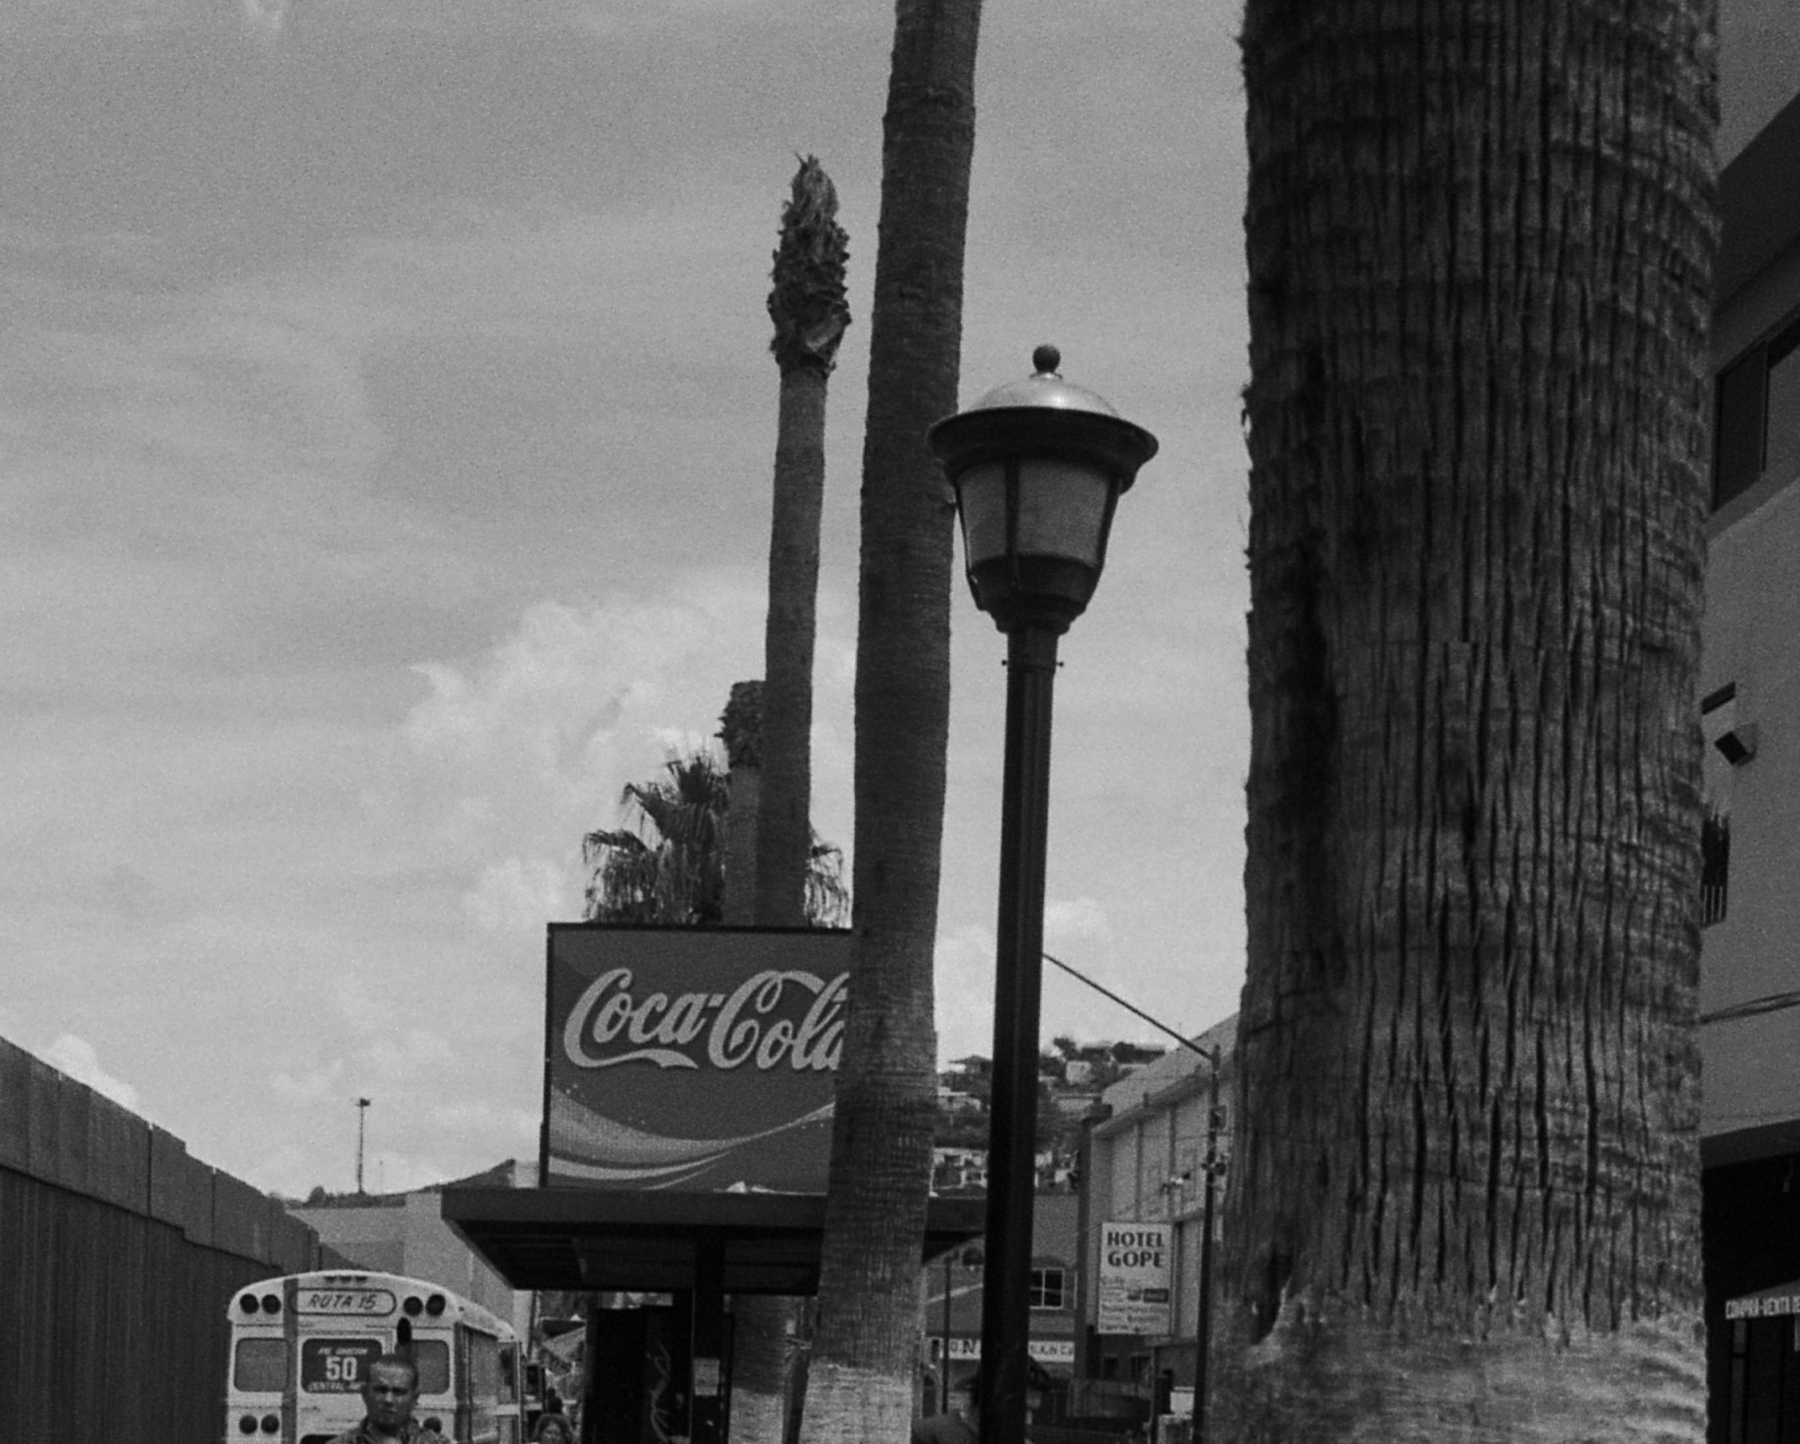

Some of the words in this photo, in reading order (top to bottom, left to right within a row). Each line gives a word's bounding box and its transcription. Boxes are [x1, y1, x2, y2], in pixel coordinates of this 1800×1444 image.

[563, 966, 850, 1071] Coca-Cola
[1107, 1231, 1165, 1248] HOTEL
[1107, 1250, 1166, 1268] GOPE
[307, 1293, 353, 1308] RUTA
[358, 1293, 378, 1310] 15
[326, 1355, 358, 1381] 50
